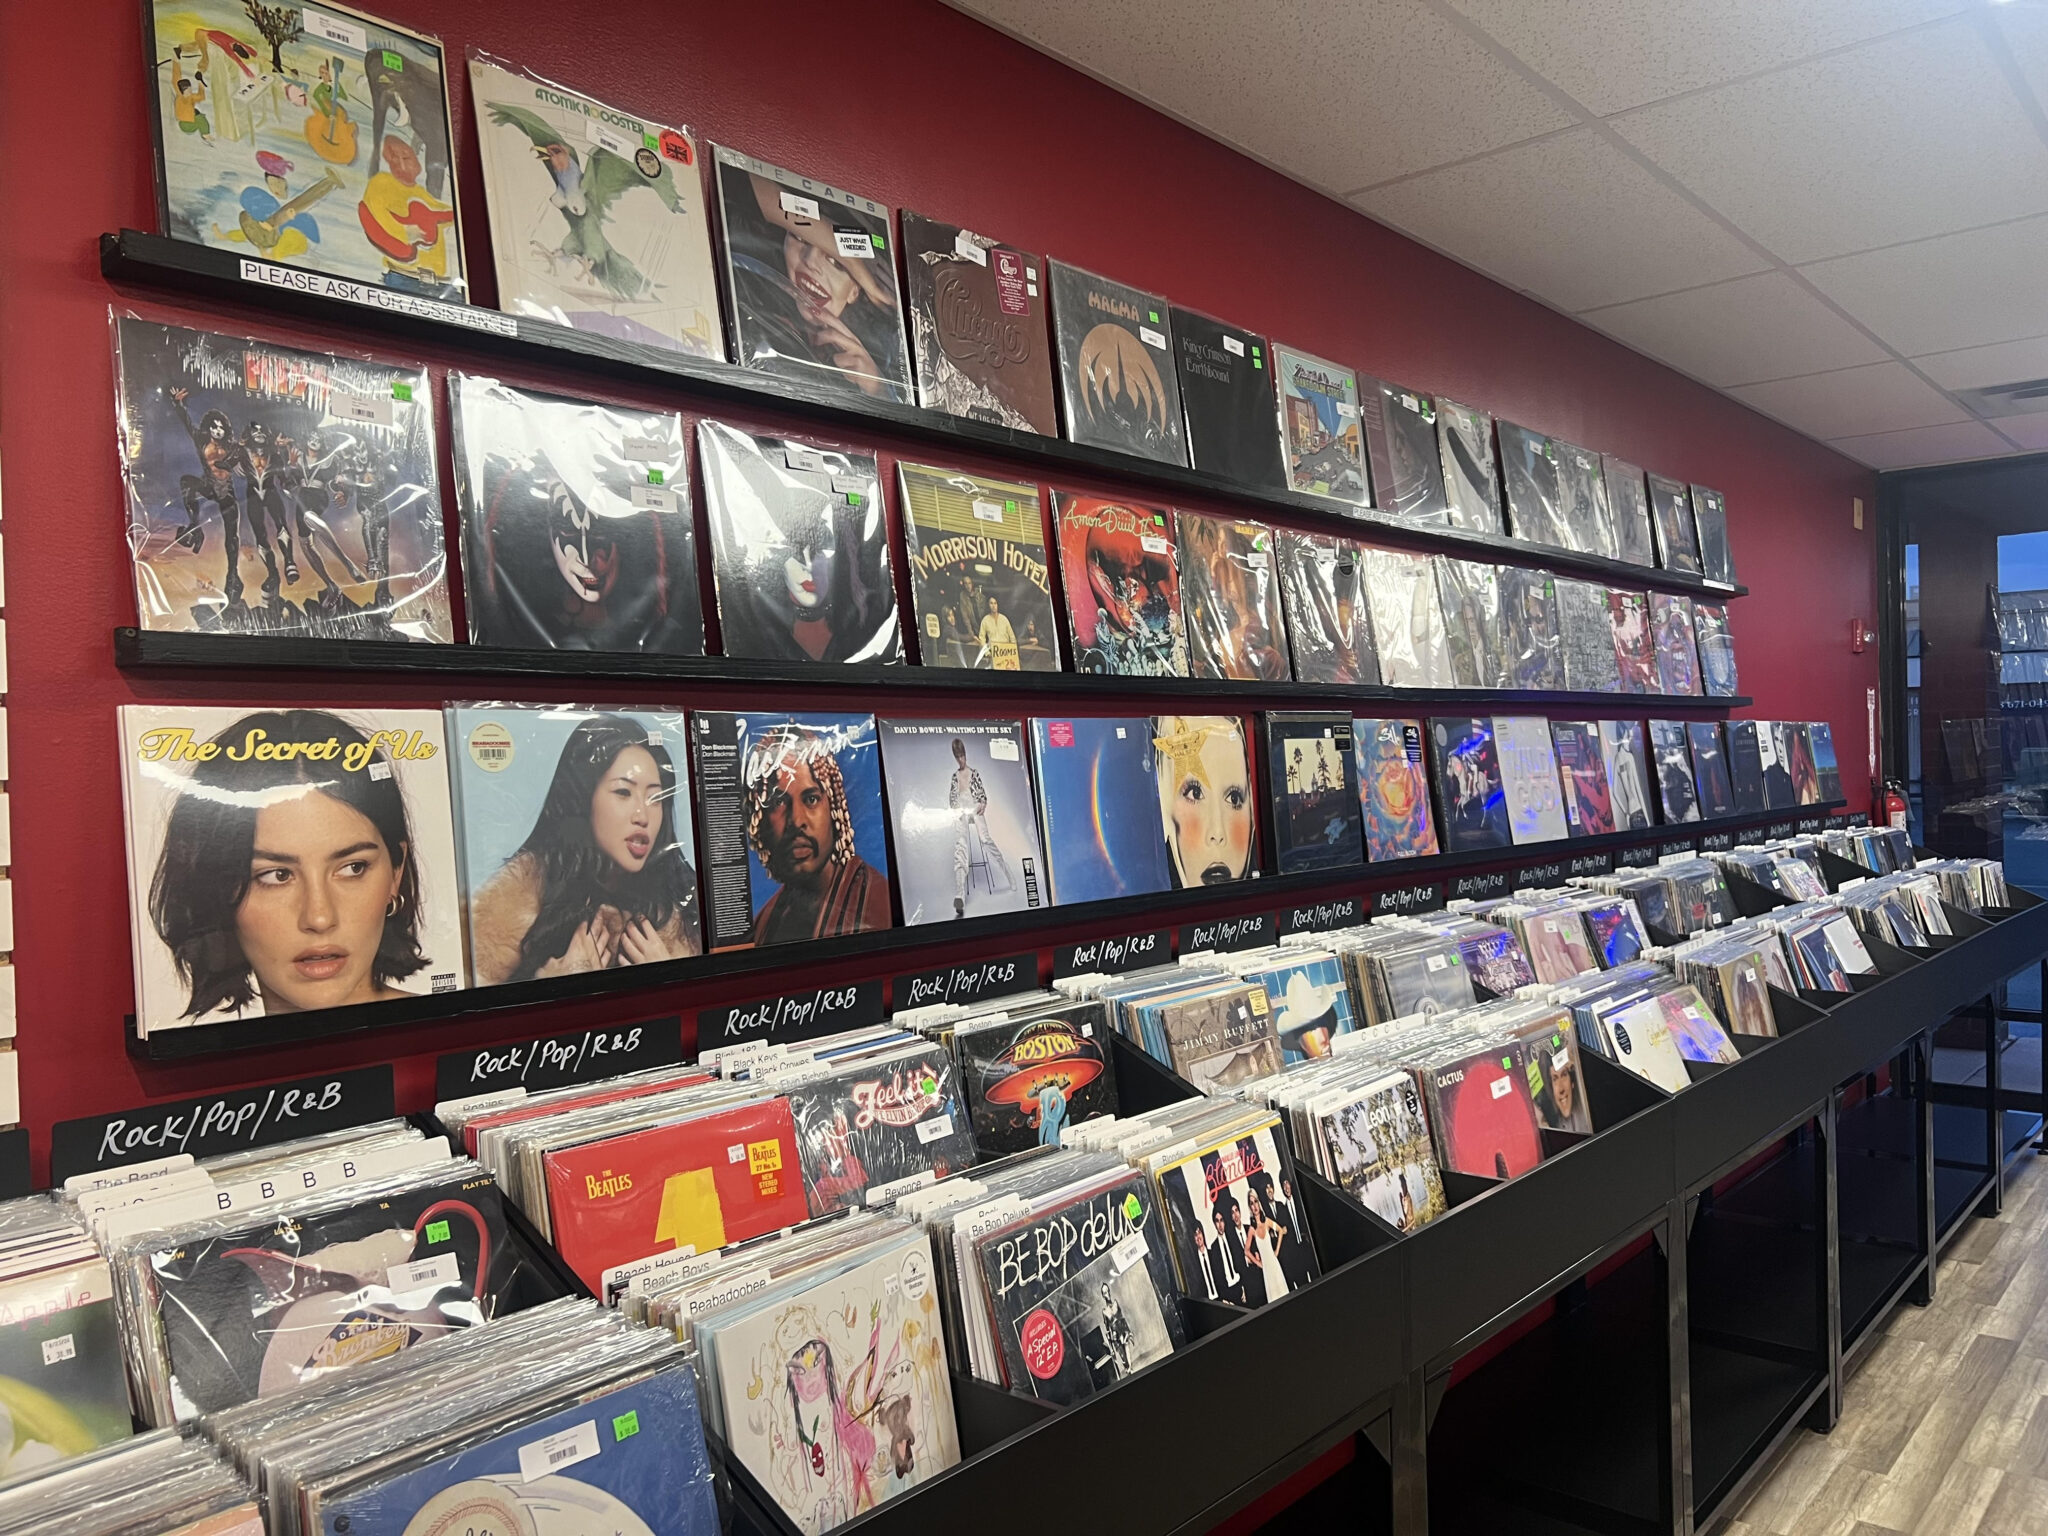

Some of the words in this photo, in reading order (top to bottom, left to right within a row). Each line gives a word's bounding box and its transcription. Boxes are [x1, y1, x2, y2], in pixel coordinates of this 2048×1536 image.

[535, 88, 581, 112] ATOMIC
[730, 153, 784, 181] THE
[802, 178, 875, 212] CARS
[840, 236, 852, 244] JUST
[244, 263, 319, 292] PLEASE
[325, 282, 360, 301] ASK
[367, 289, 402, 311] FOR
[1088, 290, 1140, 322] MAGMA
[1182, 336, 1203, 359] King
[1202, 345, 1231, 365] Crimson
[1186, 357, 1230, 384] Earthbound
[913, 535, 997, 580] MORRISON
[1004, 541, 1050, 595] HOTEL
[894, 726, 917, 734] DAVID
[919, 726, 943, 734] BOWIE
[946, 726, 976, 734] WAITING
[977, 726, 984, 734] IN
[985, 726, 999, 734] THE
[1000, 726, 1012, 734] SKY
[138, 728, 221, 761] The
[226, 728, 342, 761] Secret
[342, 730, 390, 772] of
[387, 729, 438, 760] Us
[908, 963, 1015, 1005] Rock/Pop/R&B
[724, 987, 857, 1036] Rock/Pop/R&B
[968, 1020, 992, 1032] Boston
[1183, 1032, 1220, 1050] JIMMY
[1223, 1018, 1270, 1039] BUFFETT
[1361, 1031, 1367, 1041] C
[1372, 1028, 1378, 1037] C
[1384, 1024, 1389, 1033] C
[1395, 1020, 1401, 1030] C
[470, 1028, 642, 1082] Rock/Pop/R&B
[1013, 1032, 1076, 1062] BOSTON
[733, 1056, 756, 1071] Black
[755, 1063, 778, 1079] Black
[1437, 1069, 1464, 1088] CACTUS
[97, 1082, 342, 1161] Rock/Pop/R&B
[1361, 1104, 1391, 1131] Leon
[752, 1148, 777, 1162] BEATLES
[218, 1192, 232, 1210] B
[261, 1182, 275, 1199] B
[303, 1171, 317, 1188] B
[343, 1161, 357, 1178] B
[585, 1173, 633, 1200] BEATLES
[602, 1168, 612, 1177] THE
[758, 1178, 778, 1189] STEREO
[761, 1172, 773, 1180] NEW
[1204, 1146, 1265, 1208] Blondie
[379, 1202, 390, 1210] YA
[462, 1181, 479, 1191] PLAY
[761, 1186, 778, 1196] MIXES
[971, 1224, 983, 1238] Be
[986, 1217, 1002, 1233] Bop
[1002, 1205, 1030, 1224] Deluxe
[997, 1232, 1031, 1297] BE
[1034, 1216, 1078, 1280] BOP
[642, 1268, 679, 1291] Beach
[682, 1261, 710, 1278] Boys
[689, 1277, 767, 1315] Beabadoobee
[1032, 1323, 1057, 1352] Special
